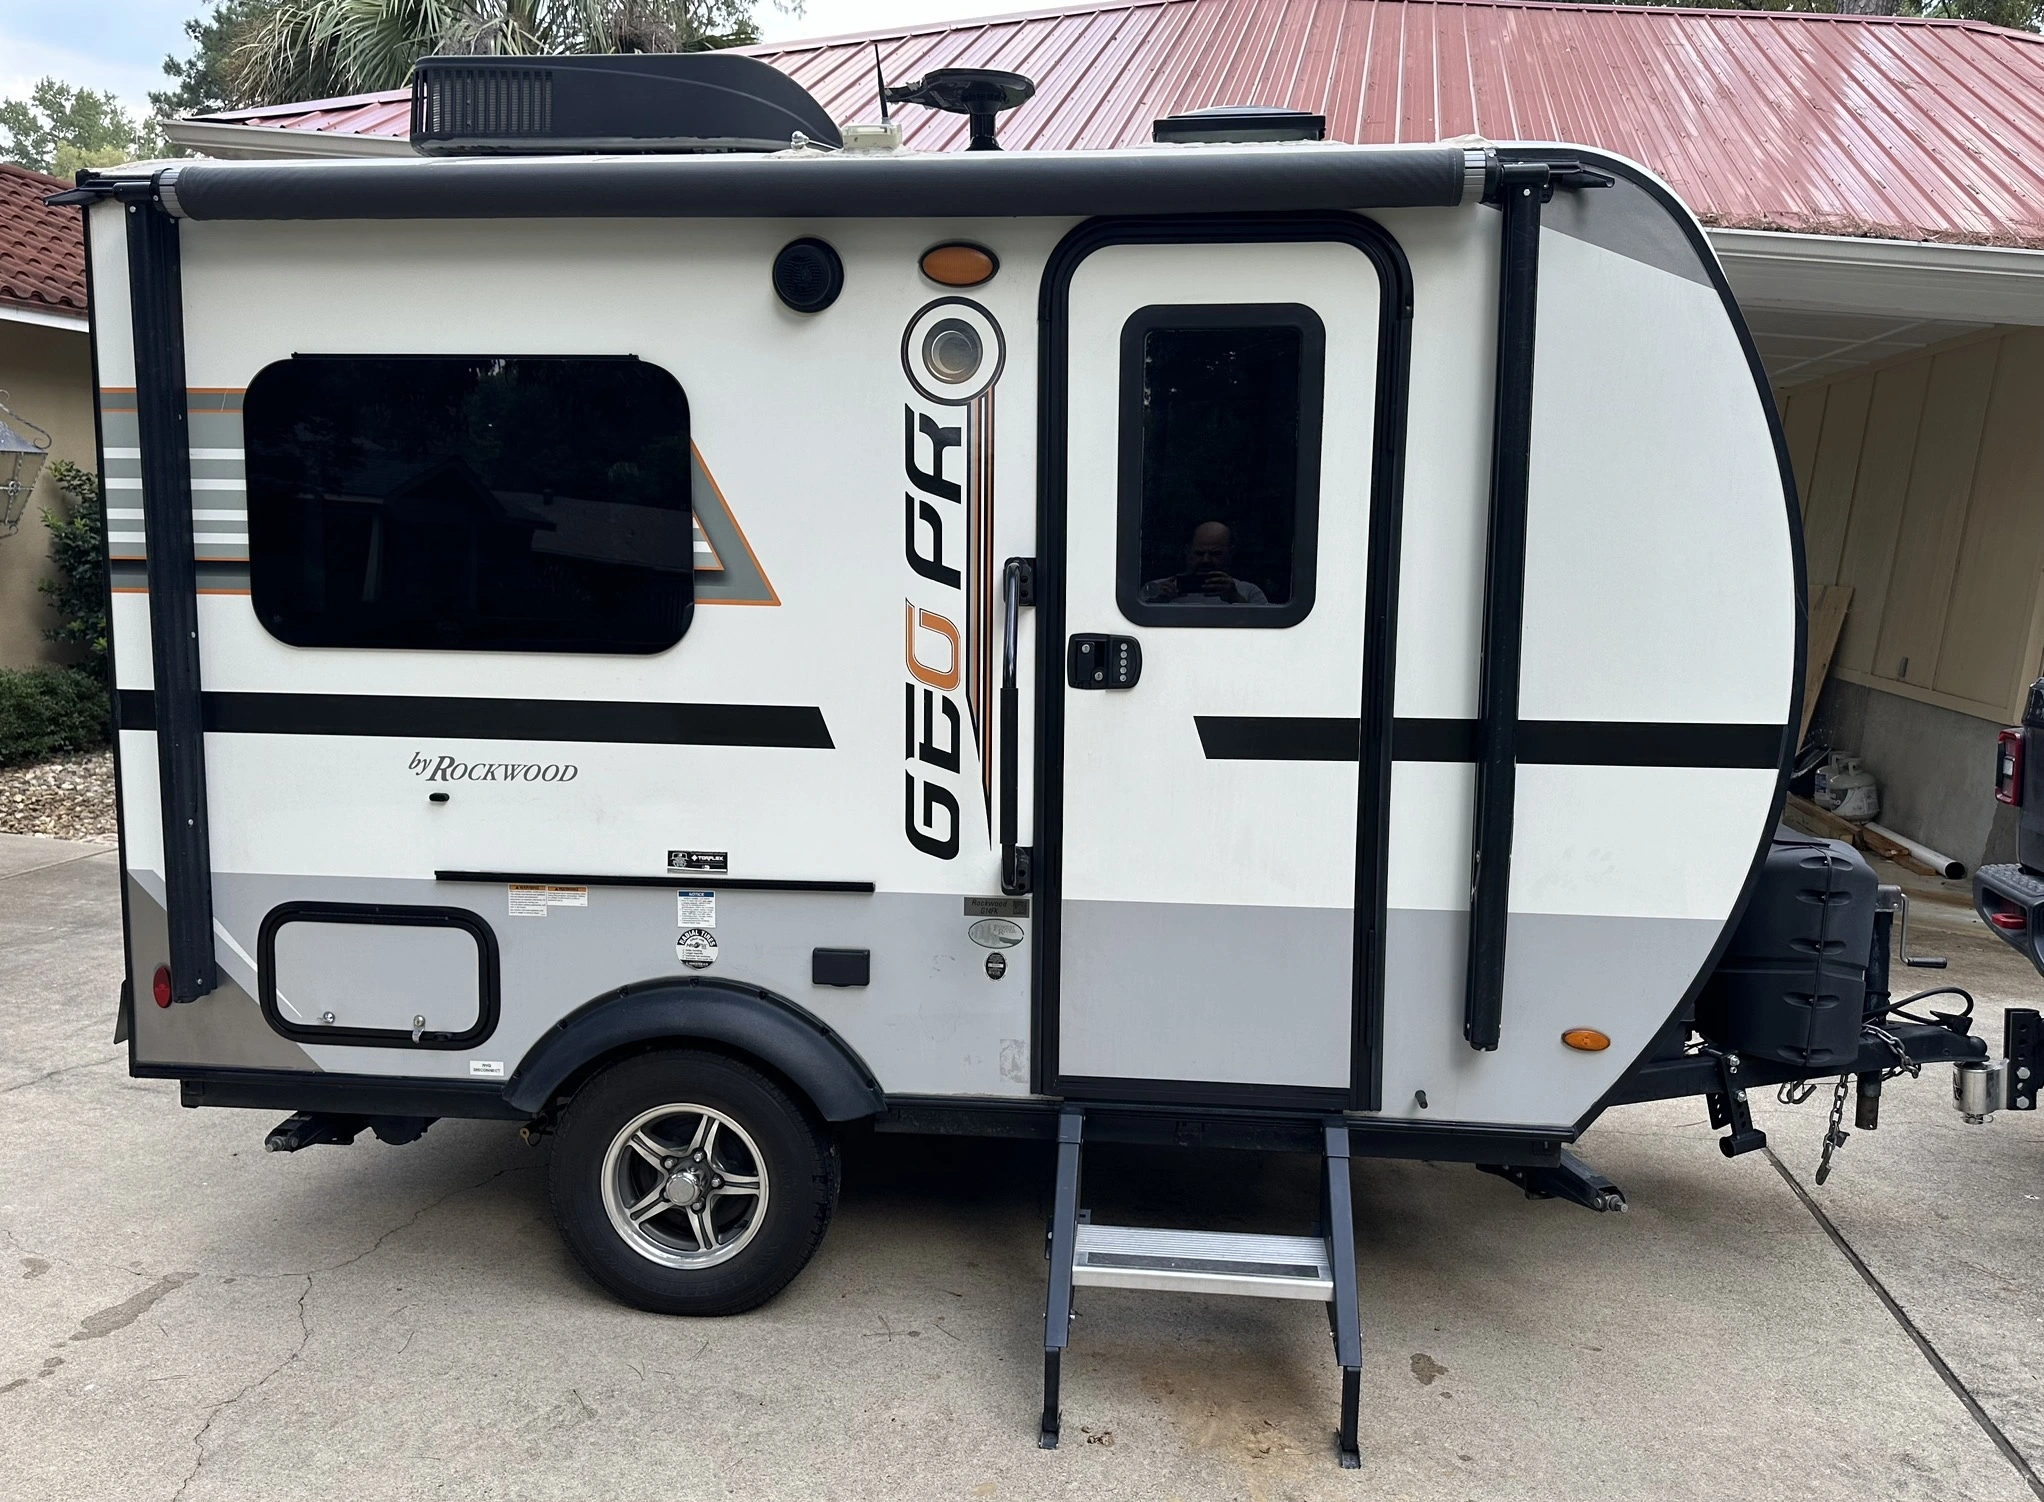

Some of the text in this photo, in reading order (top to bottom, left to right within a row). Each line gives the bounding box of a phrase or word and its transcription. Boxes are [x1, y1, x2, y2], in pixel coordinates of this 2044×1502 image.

[904, 597, 961, 861] GEO
[408, 751, 579, 782] by ROCKWOOD
[971, 898, 1008, 908] Rockwood
[980, 907, 999, 915] G14FK
[678, 929, 700, 945] RADIAL
[700, 930, 717, 947] TIRES
